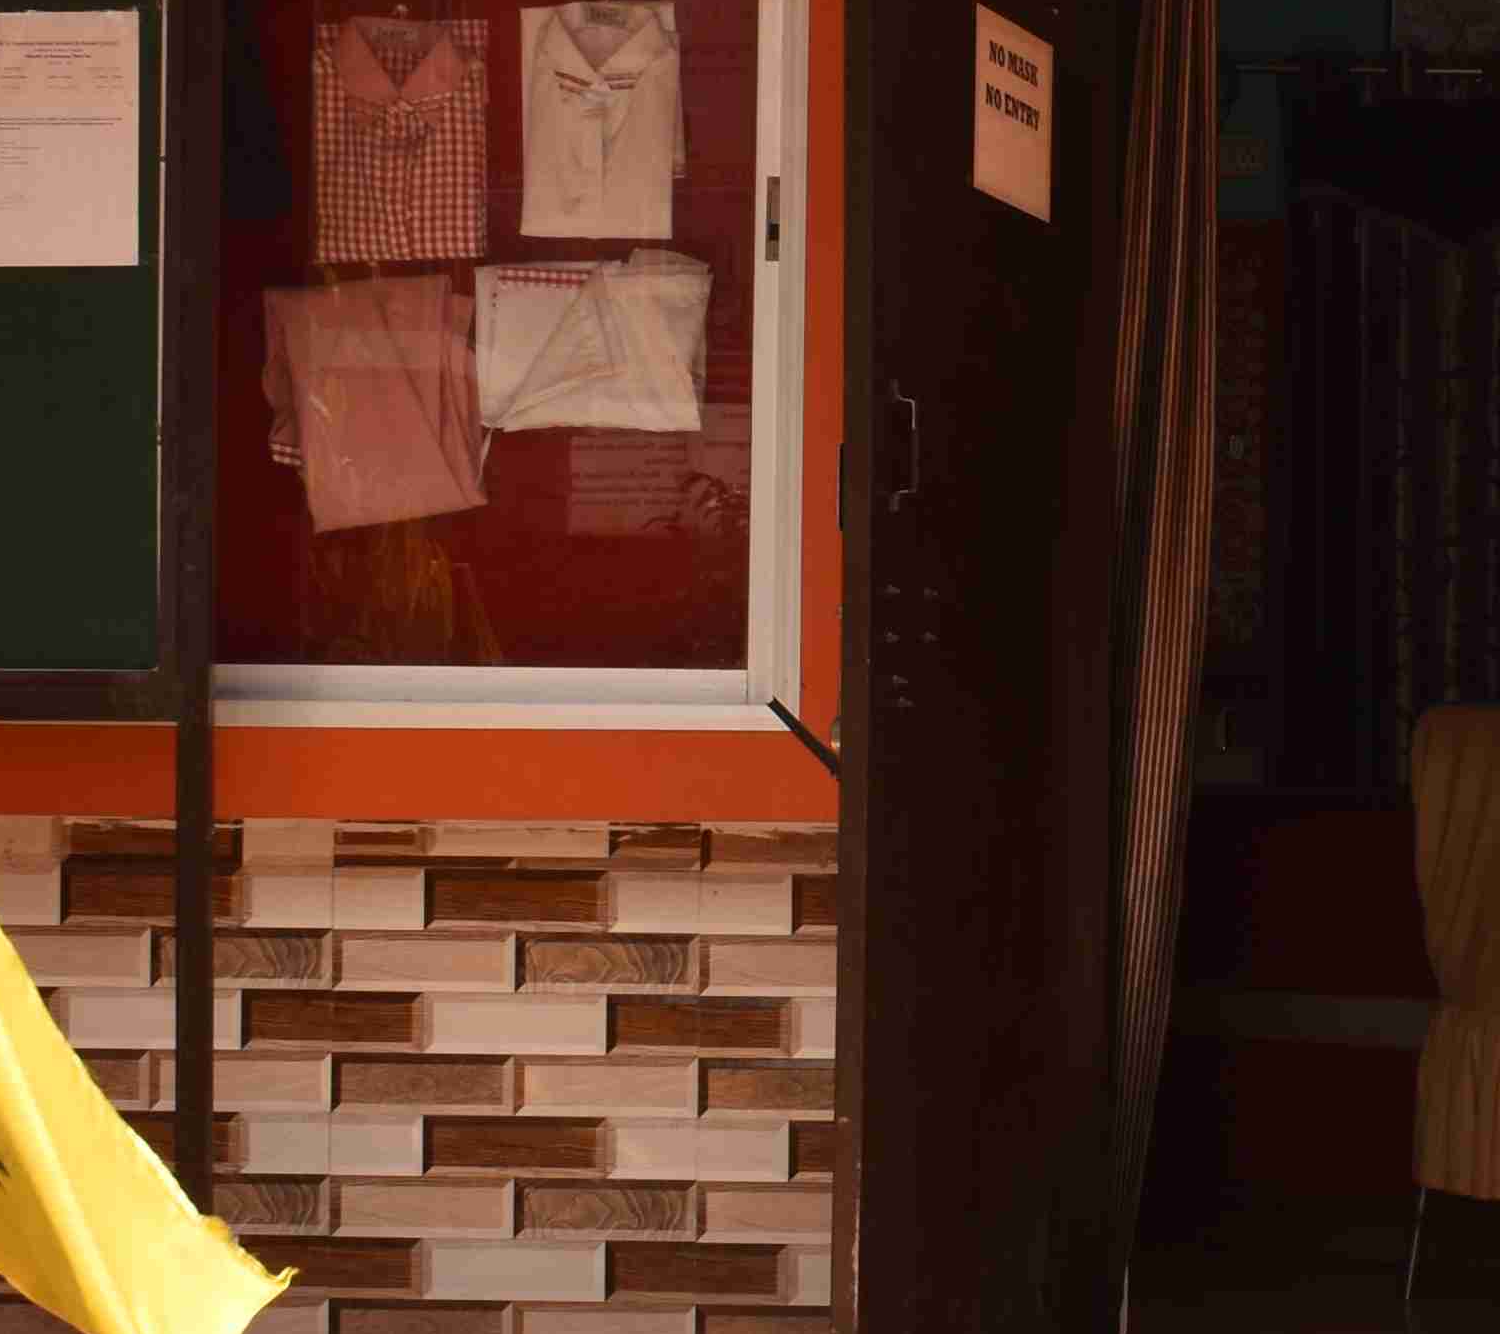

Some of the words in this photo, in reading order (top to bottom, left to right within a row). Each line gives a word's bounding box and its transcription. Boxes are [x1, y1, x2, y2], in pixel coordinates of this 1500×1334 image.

[989, 40, 1005, 68] NO
[1007, 50, 1039, 87] MASK
[985, 83, 1001, 111] NO
[1004, 92, 1040, 131] ENTRY
